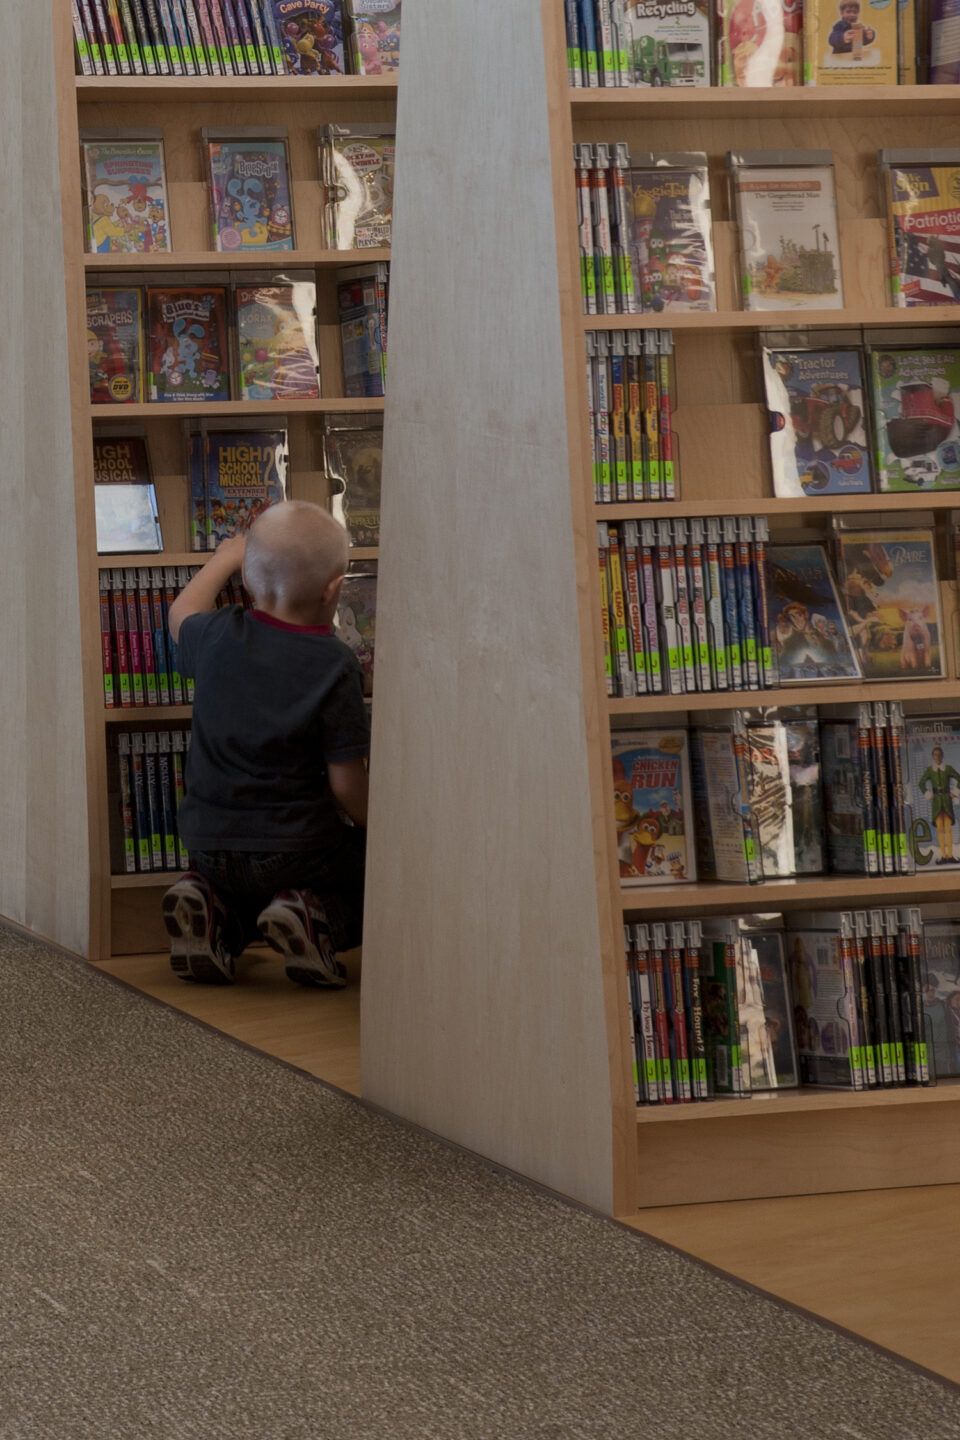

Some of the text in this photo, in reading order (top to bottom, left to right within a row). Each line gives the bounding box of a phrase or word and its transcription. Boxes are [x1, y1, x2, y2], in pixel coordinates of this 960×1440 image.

[280, 0, 303, 14] Cave
[637, 2, 696, 18] Recycling
[165, 301, 201, 315] Blue's
[87, 310, 134, 328] SCRAPERS
[799, 357, 835, 370] Tractor
[799, 370, 848, 380] Adventures
[93, 445, 131, 460] IGH
[219, 446, 275, 485] HIGH 2
[219, 462, 262, 474] SCHOOL
[219, 474, 263, 486] MUSICAL
[613, 590, 625, 617] ELMO
[159, 756, 169, 784] MOLLY
[632, 761, 678, 771] CHICKEN
[631, 772, 678, 789] RUN
[691, 977, 700, 998] Fox
[641, 1000, 650, 1014] Fly
[692, 1006, 705, 1043] Hound
